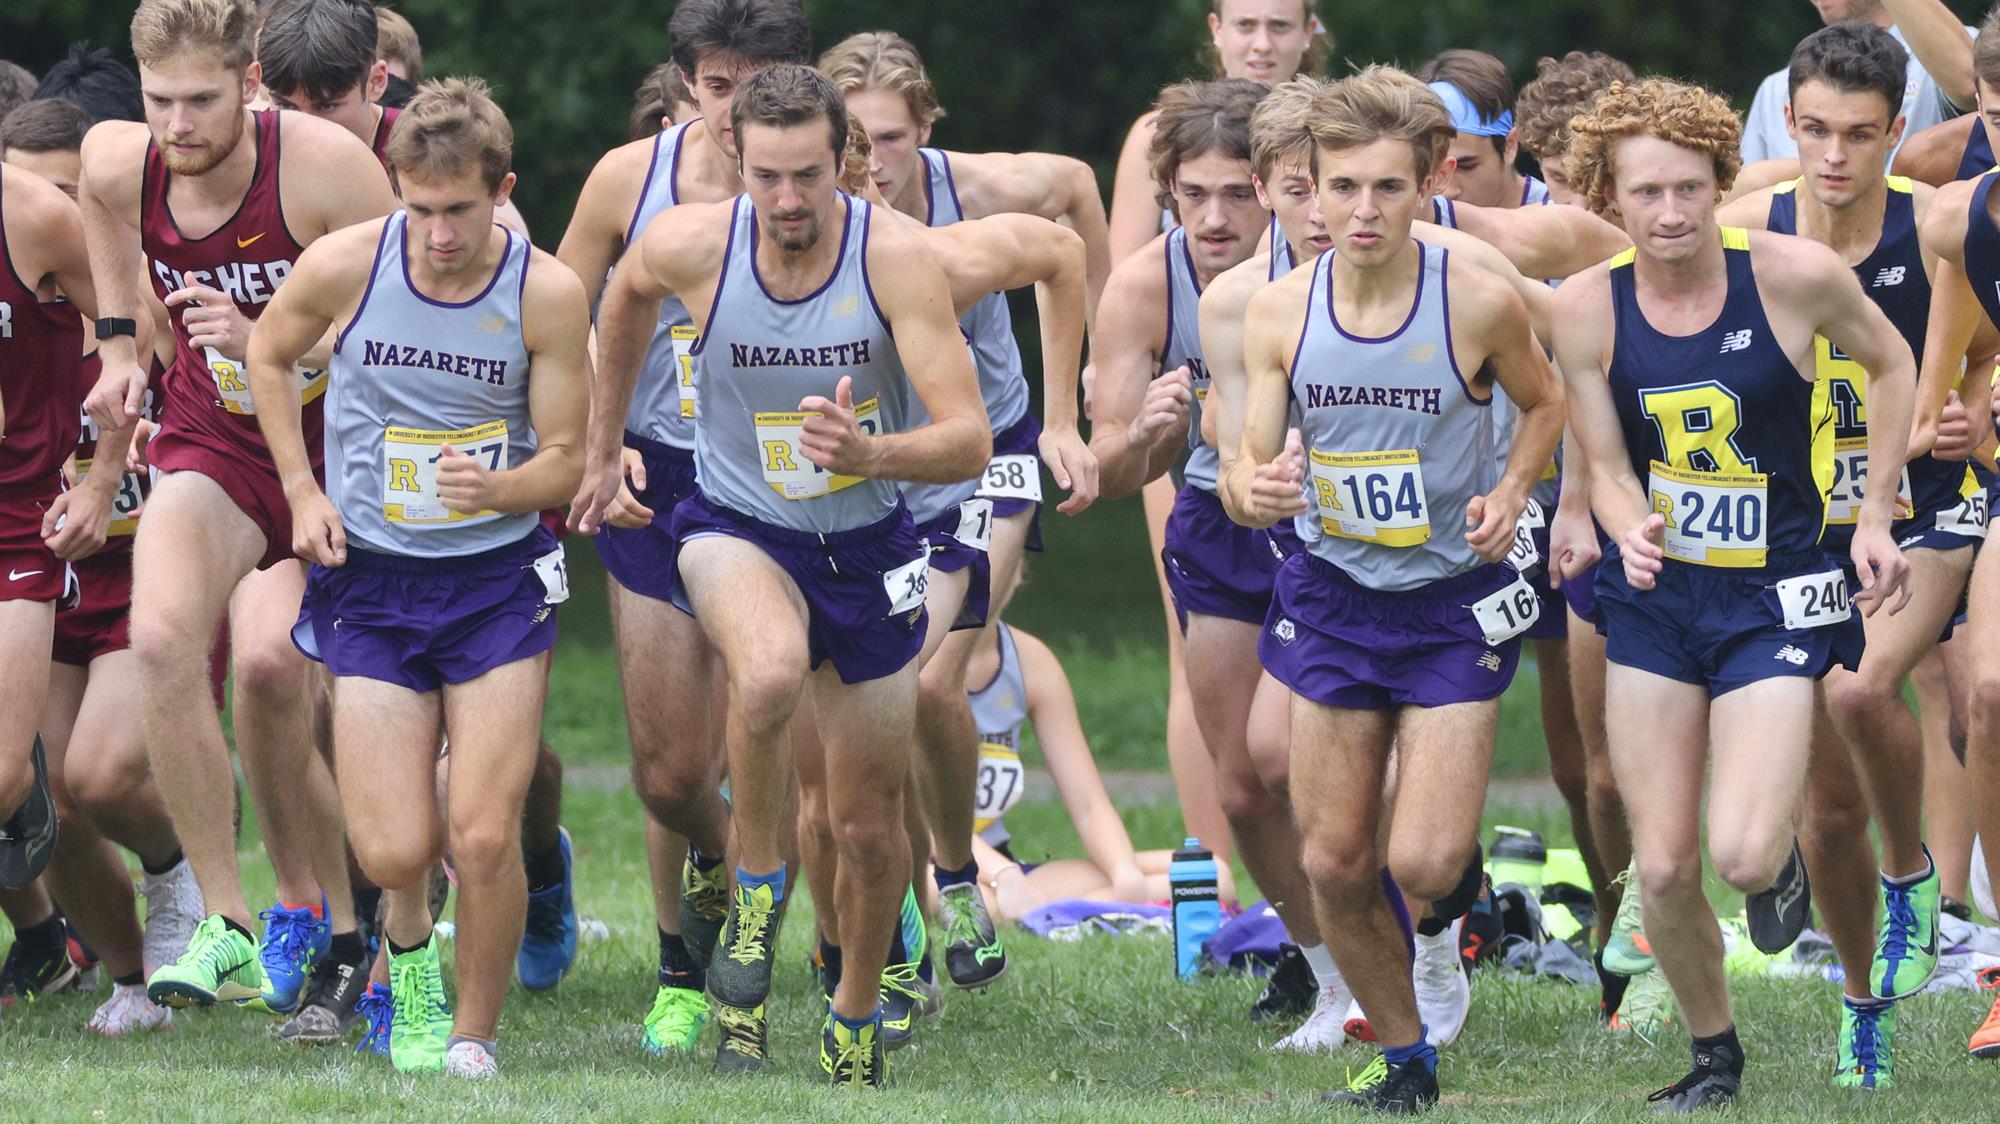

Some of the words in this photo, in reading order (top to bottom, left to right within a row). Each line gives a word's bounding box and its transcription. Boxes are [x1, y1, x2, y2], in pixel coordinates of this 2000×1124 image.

[363, 339, 507, 386] NAZARETH
[730, 339, 871, 368] NAZARETH
[212, 362, 246, 391] R
[1306, 383, 1441, 416] NAZARETH
[1638, 379, 1758, 474] R
[763, 440, 797, 471] R
[389, 458, 420, 492] R
[1314, 475, 1343, 511] R
[1342, 472, 1422, 522] 164
[1652, 489, 1676, 529] R
[1681, 491, 1761, 541] 240
[1800, 579, 1847, 617] 240
